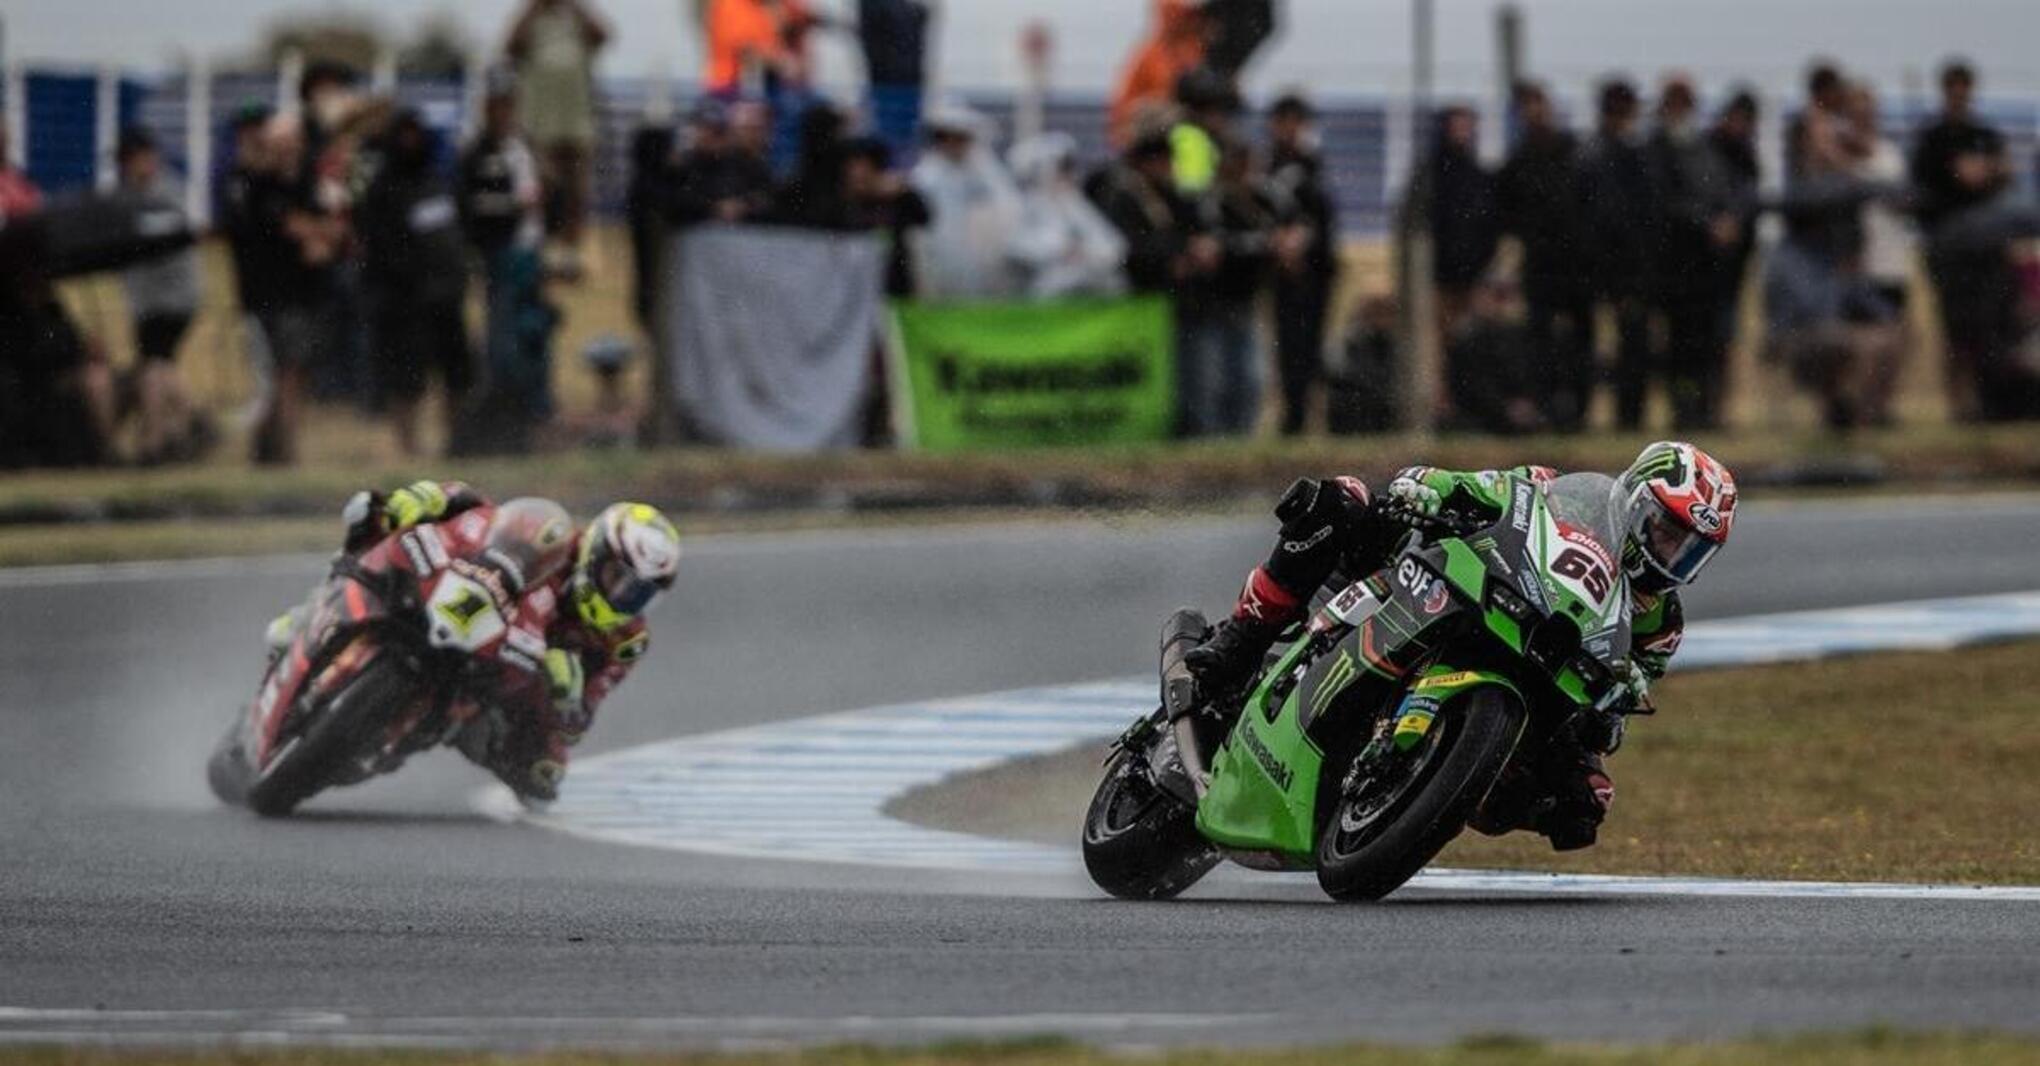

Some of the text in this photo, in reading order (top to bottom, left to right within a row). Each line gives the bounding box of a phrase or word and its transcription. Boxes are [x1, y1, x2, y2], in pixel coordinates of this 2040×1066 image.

[1512, 482, 1533, 533] Kawasaki
[1398, 558, 1432, 596] elf
[1550, 548, 1610, 605] 65
[1241, 712, 1295, 793] Kawasaki
